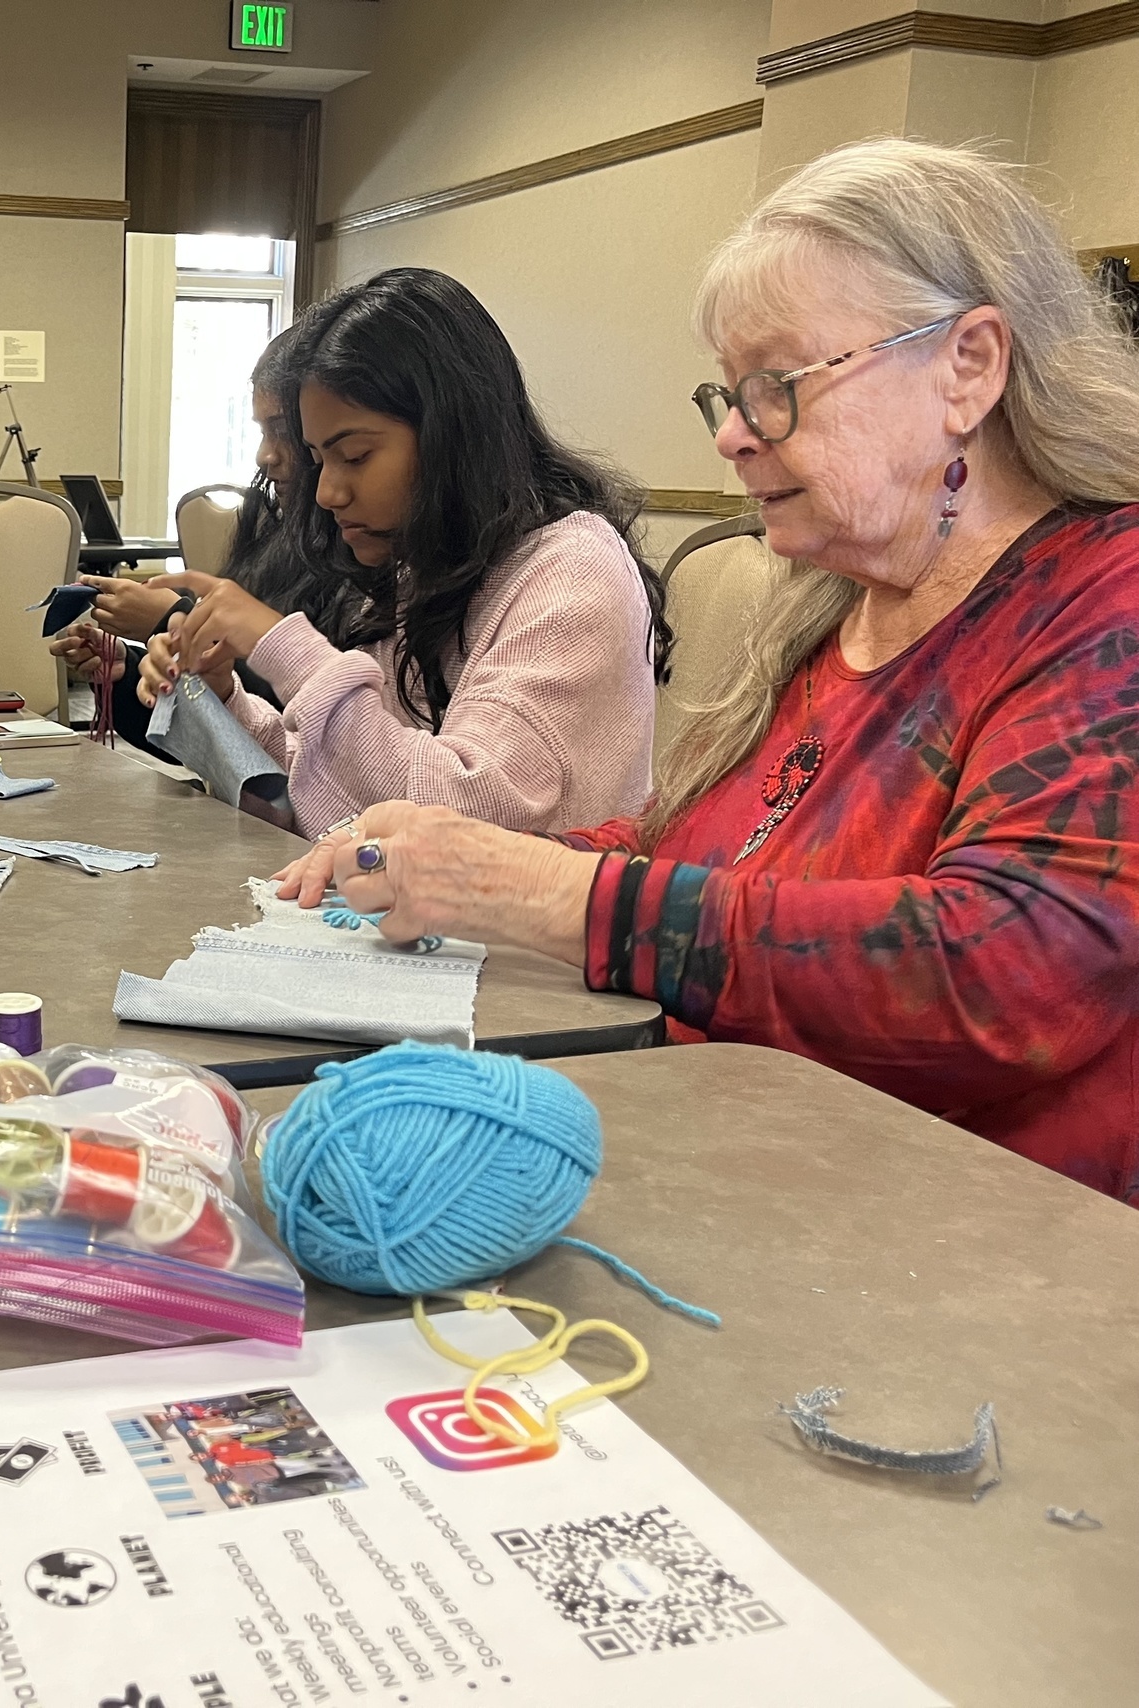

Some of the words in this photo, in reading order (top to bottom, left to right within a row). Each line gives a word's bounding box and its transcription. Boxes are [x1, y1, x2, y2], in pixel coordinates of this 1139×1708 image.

[242, 4, 287, 47] EXIT
[62, 1430, 108, 1476] PROFIT
[375, 1456, 406, 1480] us!
[400, 1480, 433, 1513] with
[119, 1534, 173, 1597] PLANET
[282, 1529, 344, 1607] consulting
[328, 1497, 406, 1591] opportunities
[426, 1512, 494, 1586] Connect
[218, 1541, 290, 1636] educational
[411, 1560, 459, 1615] events
[235, 1615, 263, 1646] do:
[304, 1612, 368, 1695] meetings
[336, 1608, 402, 1688] Nonprofit
[385, 1625, 435, 1682] teams
[398, 1595, 466, 1676] Volunteer
[448, 1616, 501, 1668] Social
[255, 1648, 282, 1679] we
[281, 1637, 331, 1705] Weekly
